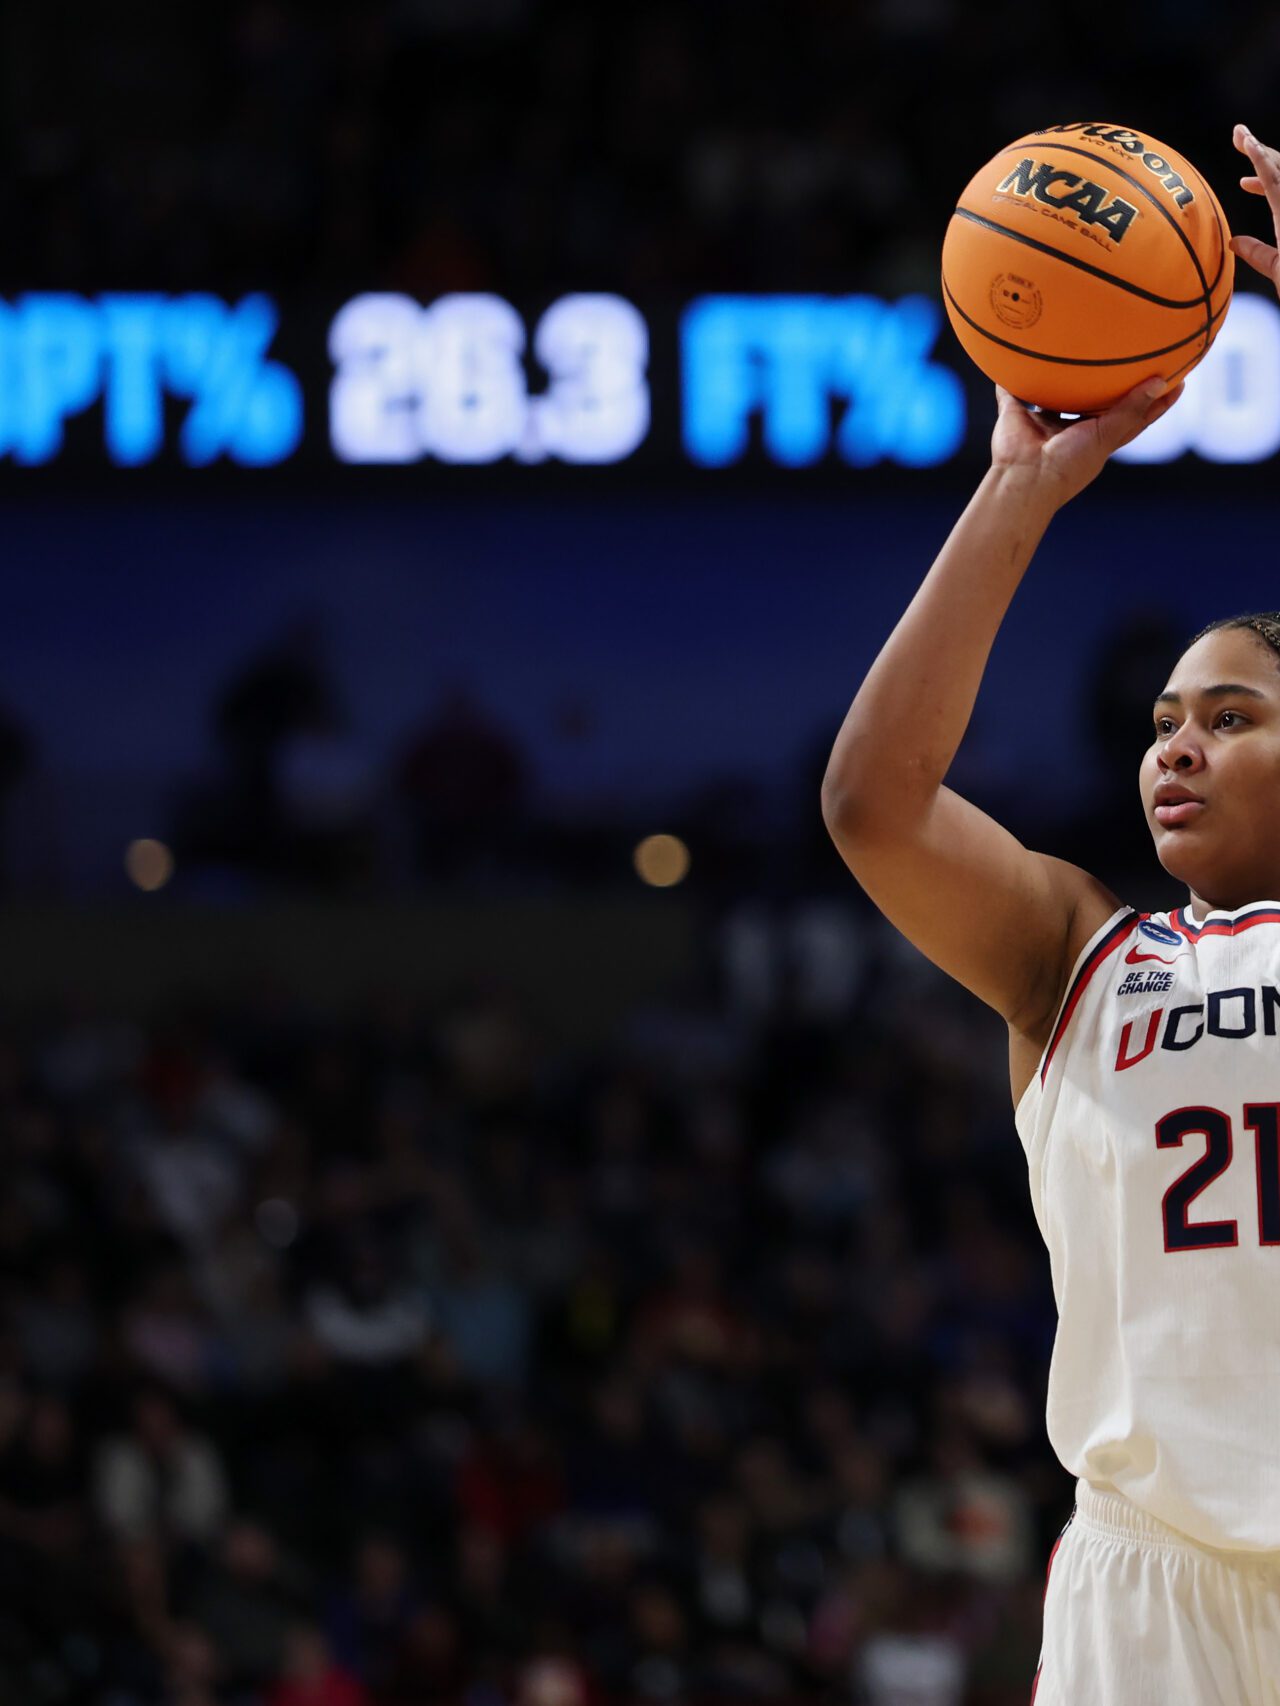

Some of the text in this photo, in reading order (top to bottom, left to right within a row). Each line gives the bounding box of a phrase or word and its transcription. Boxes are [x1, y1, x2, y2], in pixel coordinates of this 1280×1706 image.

[995, 157, 1140, 246] NCAA
[1041, 208, 1079, 231] GAME
[1080, 227, 1112, 253] BALL
[0, 290, 305, 468] PT%
[329, 291, 650, 465] 26.3
[681, 292, 966, 468] FT%
[1117, 981, 1173, 996] CHANGE
[1125, 971, 1175, 983] BE THE
